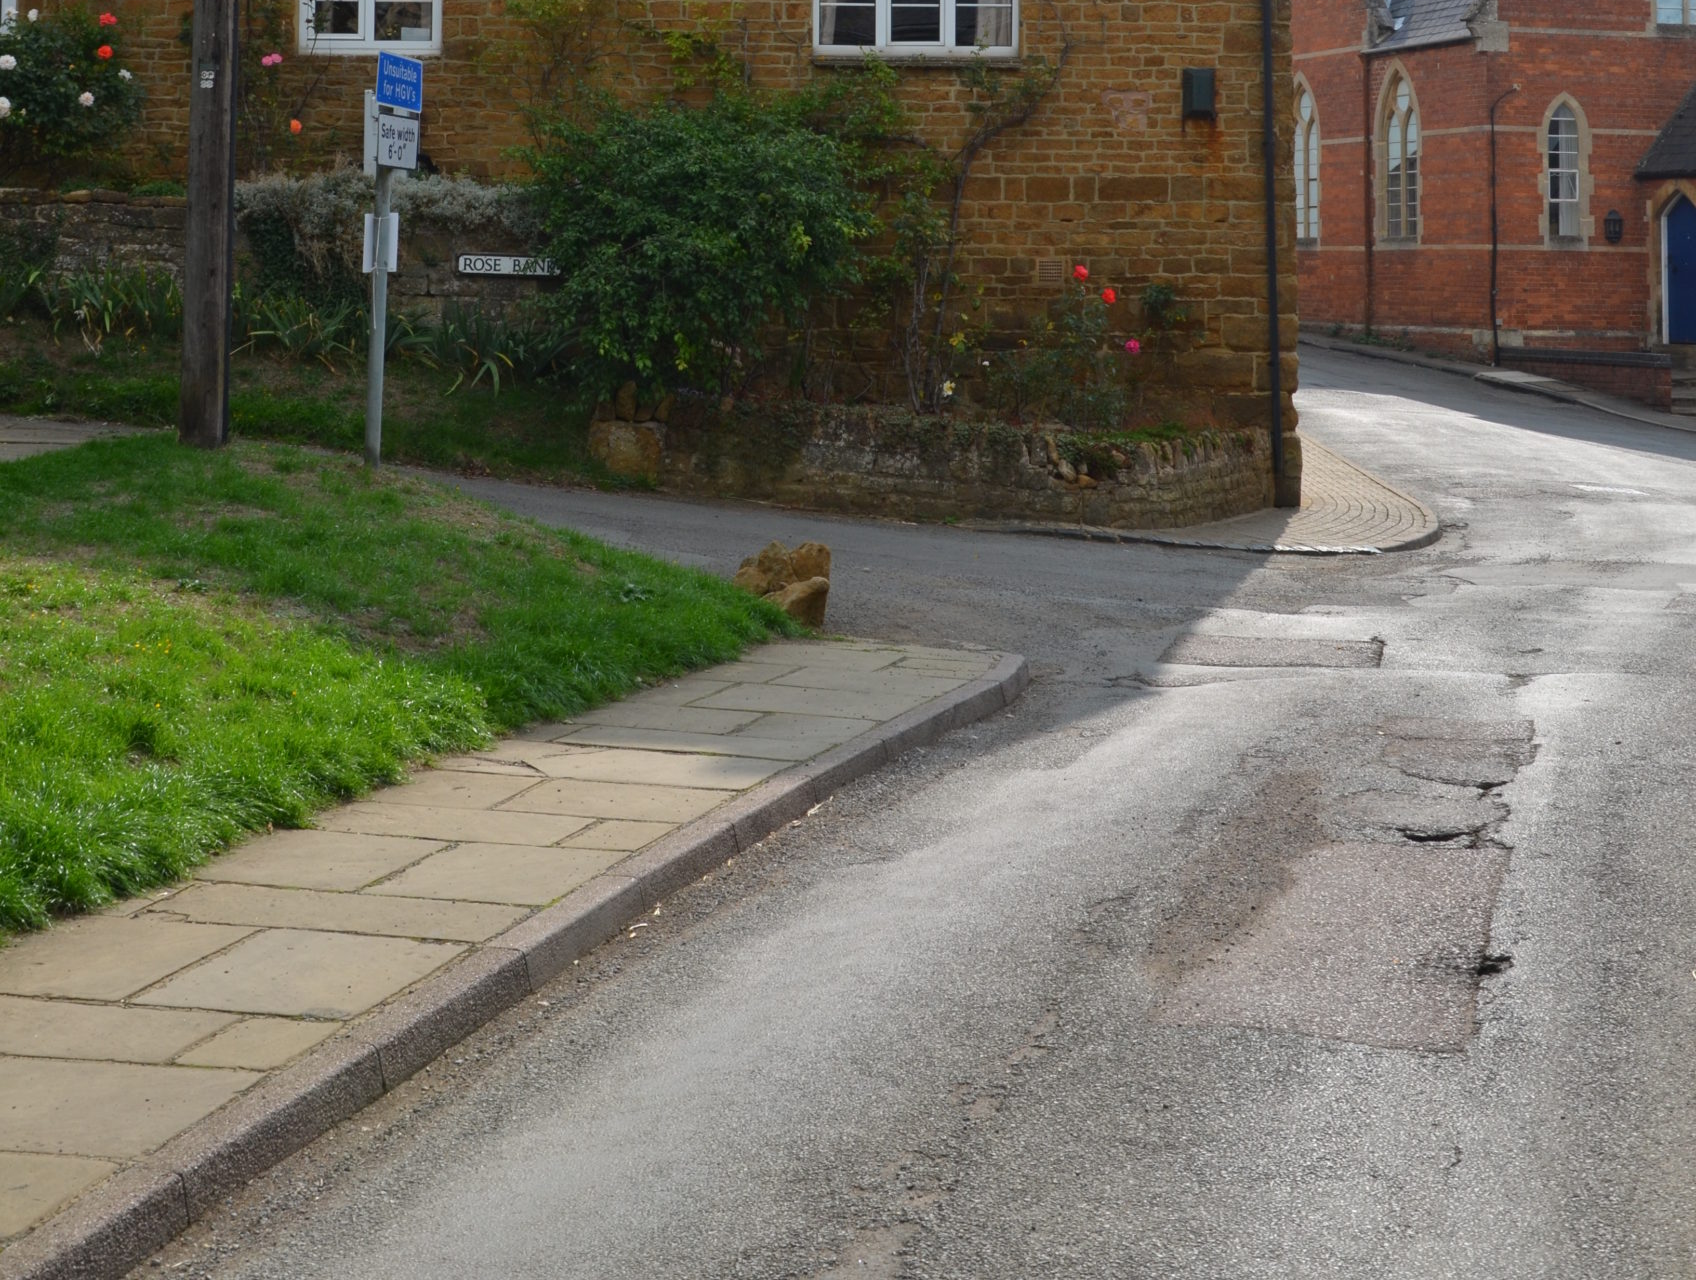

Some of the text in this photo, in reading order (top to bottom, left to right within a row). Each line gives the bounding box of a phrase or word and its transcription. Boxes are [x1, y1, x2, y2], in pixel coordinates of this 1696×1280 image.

[383, 60, 417, 82] Unsuitable
[383, 80, 416, 102] for HGV's
[381, 123, 415, 143] Safe width
[463, 257, 501, 272] ROSE
